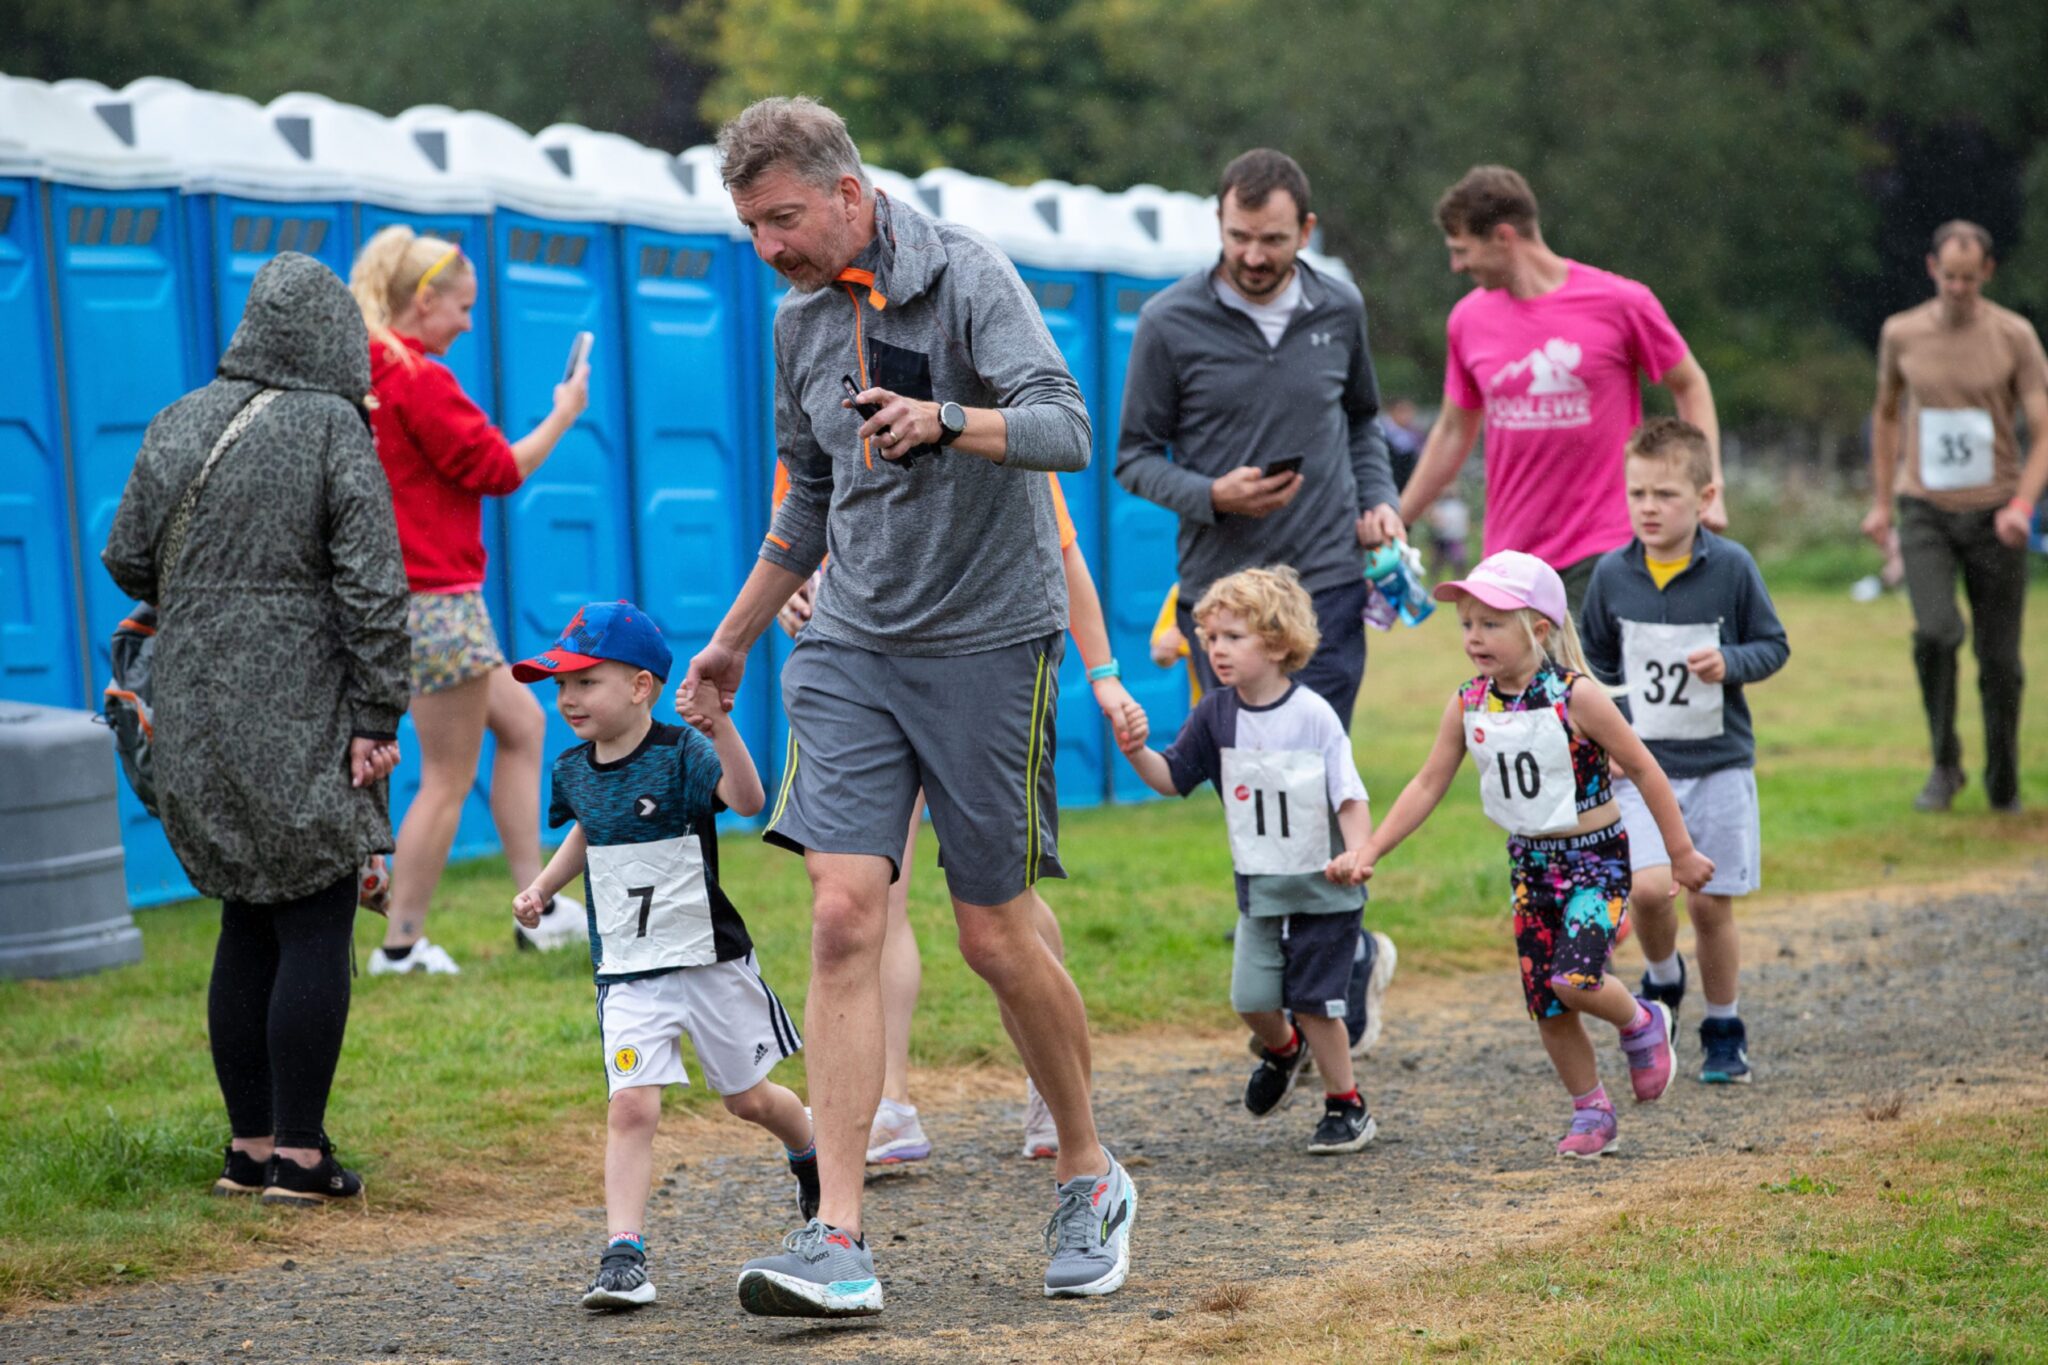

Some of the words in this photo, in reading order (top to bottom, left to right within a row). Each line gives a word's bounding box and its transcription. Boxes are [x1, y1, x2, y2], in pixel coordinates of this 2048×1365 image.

[1939, 433, 1972, 467] 35
[1644, 660, 1690, 706] 32
[1497, 751, 1541, 799] 10
[1255, 789, 1290, 838] 11
[1534, 839, 1567, 851] LOVE
[627, 886, 655, 938] 7
